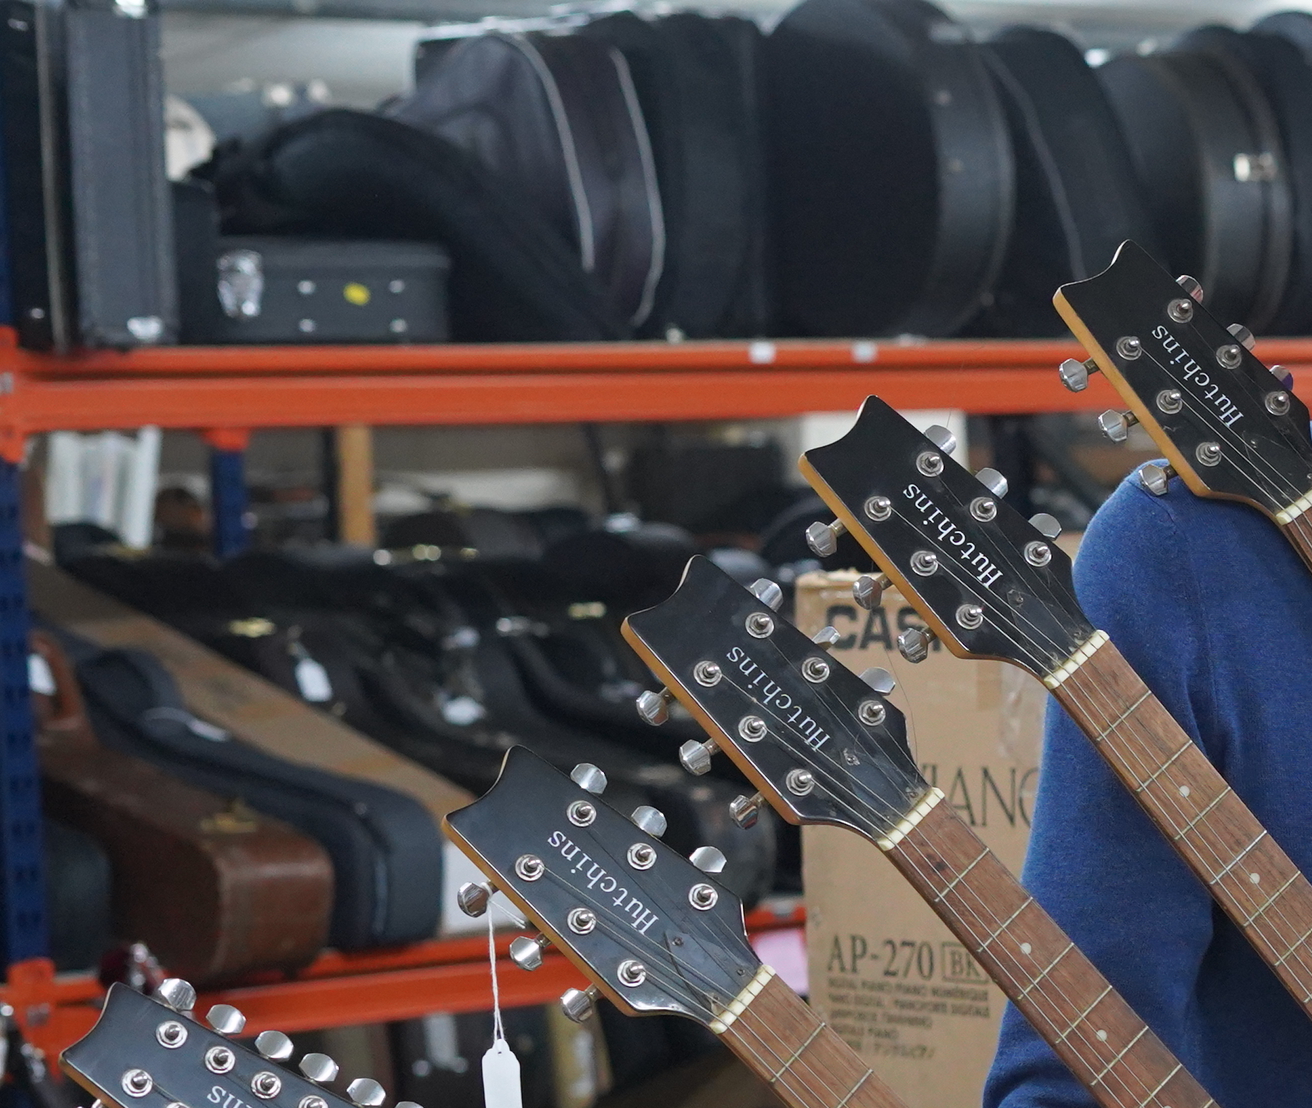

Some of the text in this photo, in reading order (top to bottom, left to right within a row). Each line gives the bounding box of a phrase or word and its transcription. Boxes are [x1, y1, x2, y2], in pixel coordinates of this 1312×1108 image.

[1152, 325, 1244, 428] Hutchins
[903, 483, 1004, 588] Hutchins
[726, 647, 832, 752] Hutchins
[548, 831, 659, 935] Hutchins
[826, 933, 935, 982] AP-270
